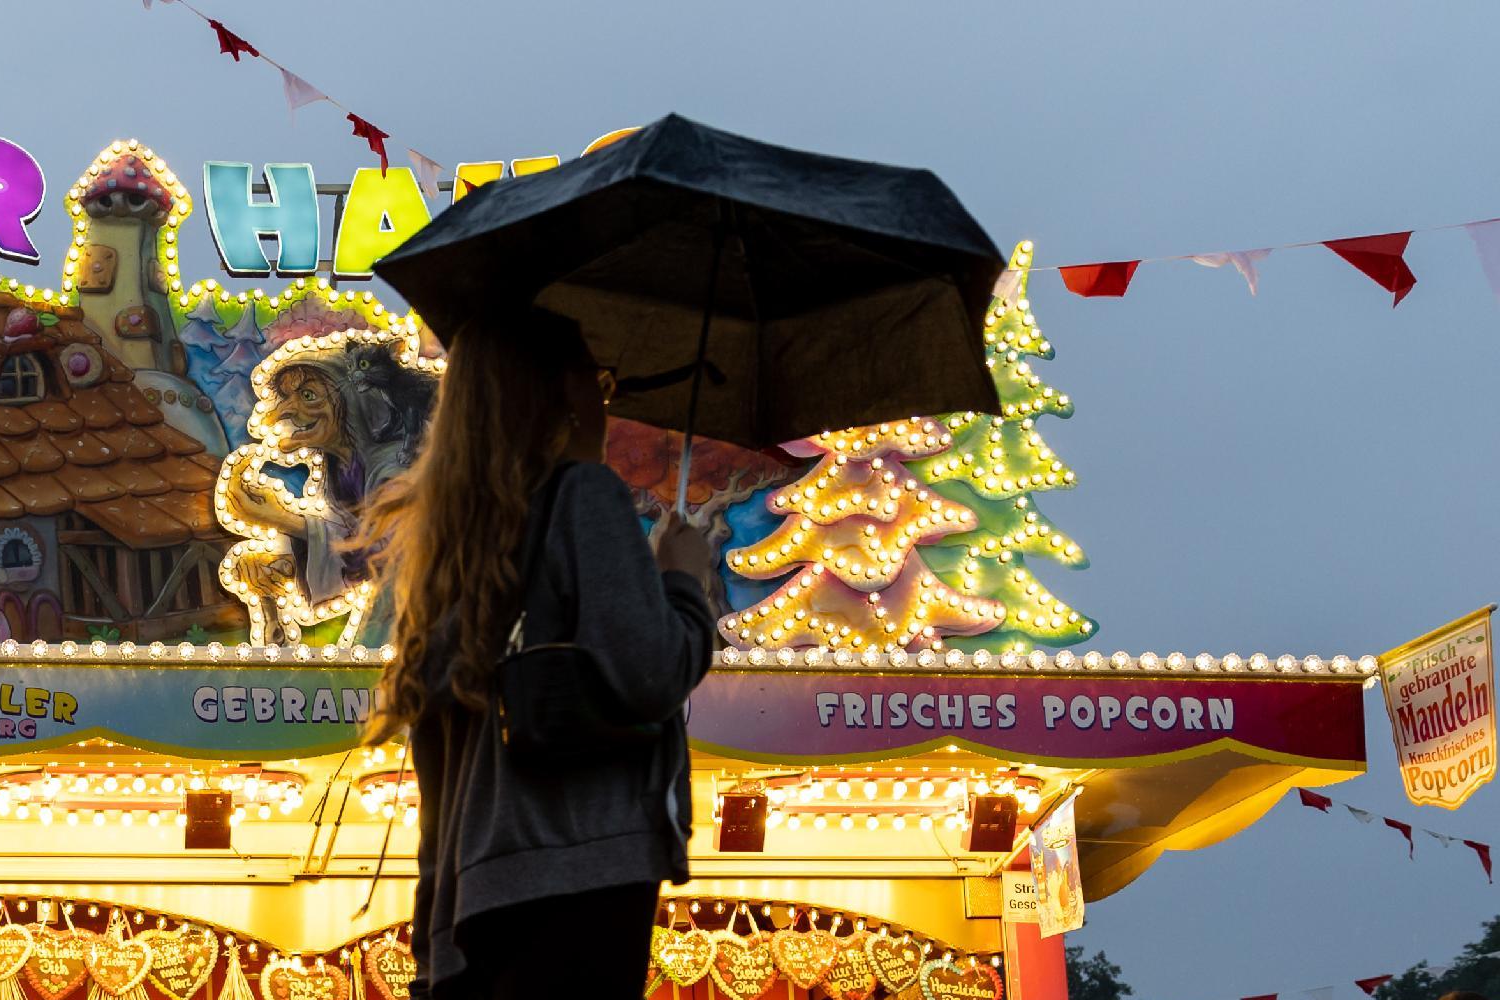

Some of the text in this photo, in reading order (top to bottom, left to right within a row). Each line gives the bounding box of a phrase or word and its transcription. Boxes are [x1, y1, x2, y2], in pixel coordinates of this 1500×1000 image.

[1399, 655, 1477, 703] gebrannte
[1412, 643, 1457, 675] Frisch
[816, 692, 1235, 732] FRISCHES POPCORN
[1396, 675, 1490, 747] Mandeln
[1407, 728, 1485, 765] Knackfrisches
[1407, 745, 1490, 797] Popcorn
[929, 976, 996, 999] Herzlichen
